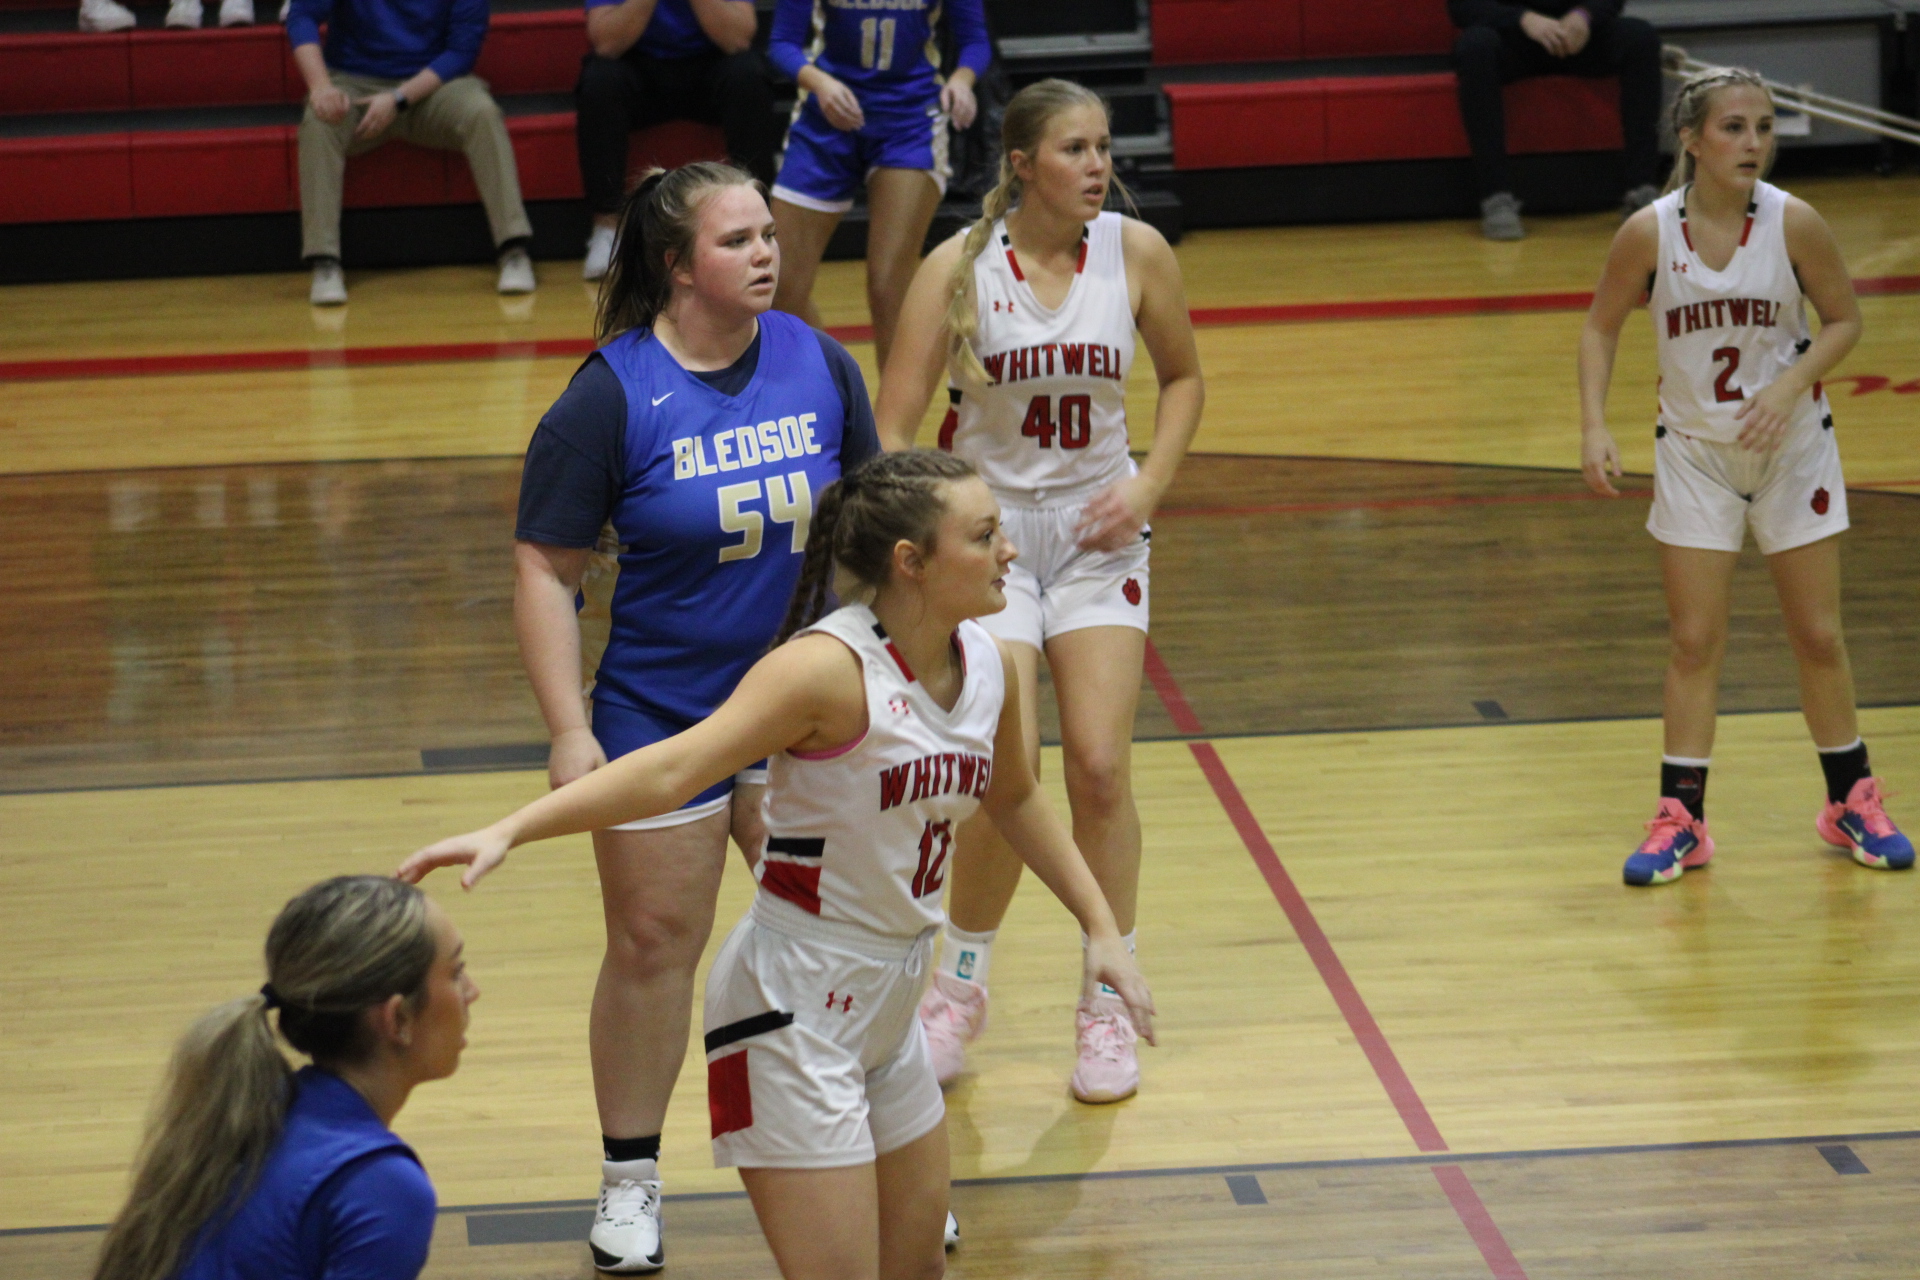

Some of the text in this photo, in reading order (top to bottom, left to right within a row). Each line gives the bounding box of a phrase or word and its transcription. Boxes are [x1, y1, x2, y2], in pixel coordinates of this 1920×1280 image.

[860, 17, 896, 71] 11
[983, 342, 1122, 387] WHITWELL
[1712, 346, 1744, 404] 2
[672, 412, 821, 480] BLEDSOE
[1021, 393, 1091, 449] 40
[717, 470, 812, 564] 54
[879, 752, 991, 812] WHITWE
[911, 819, 952, 899] 12
